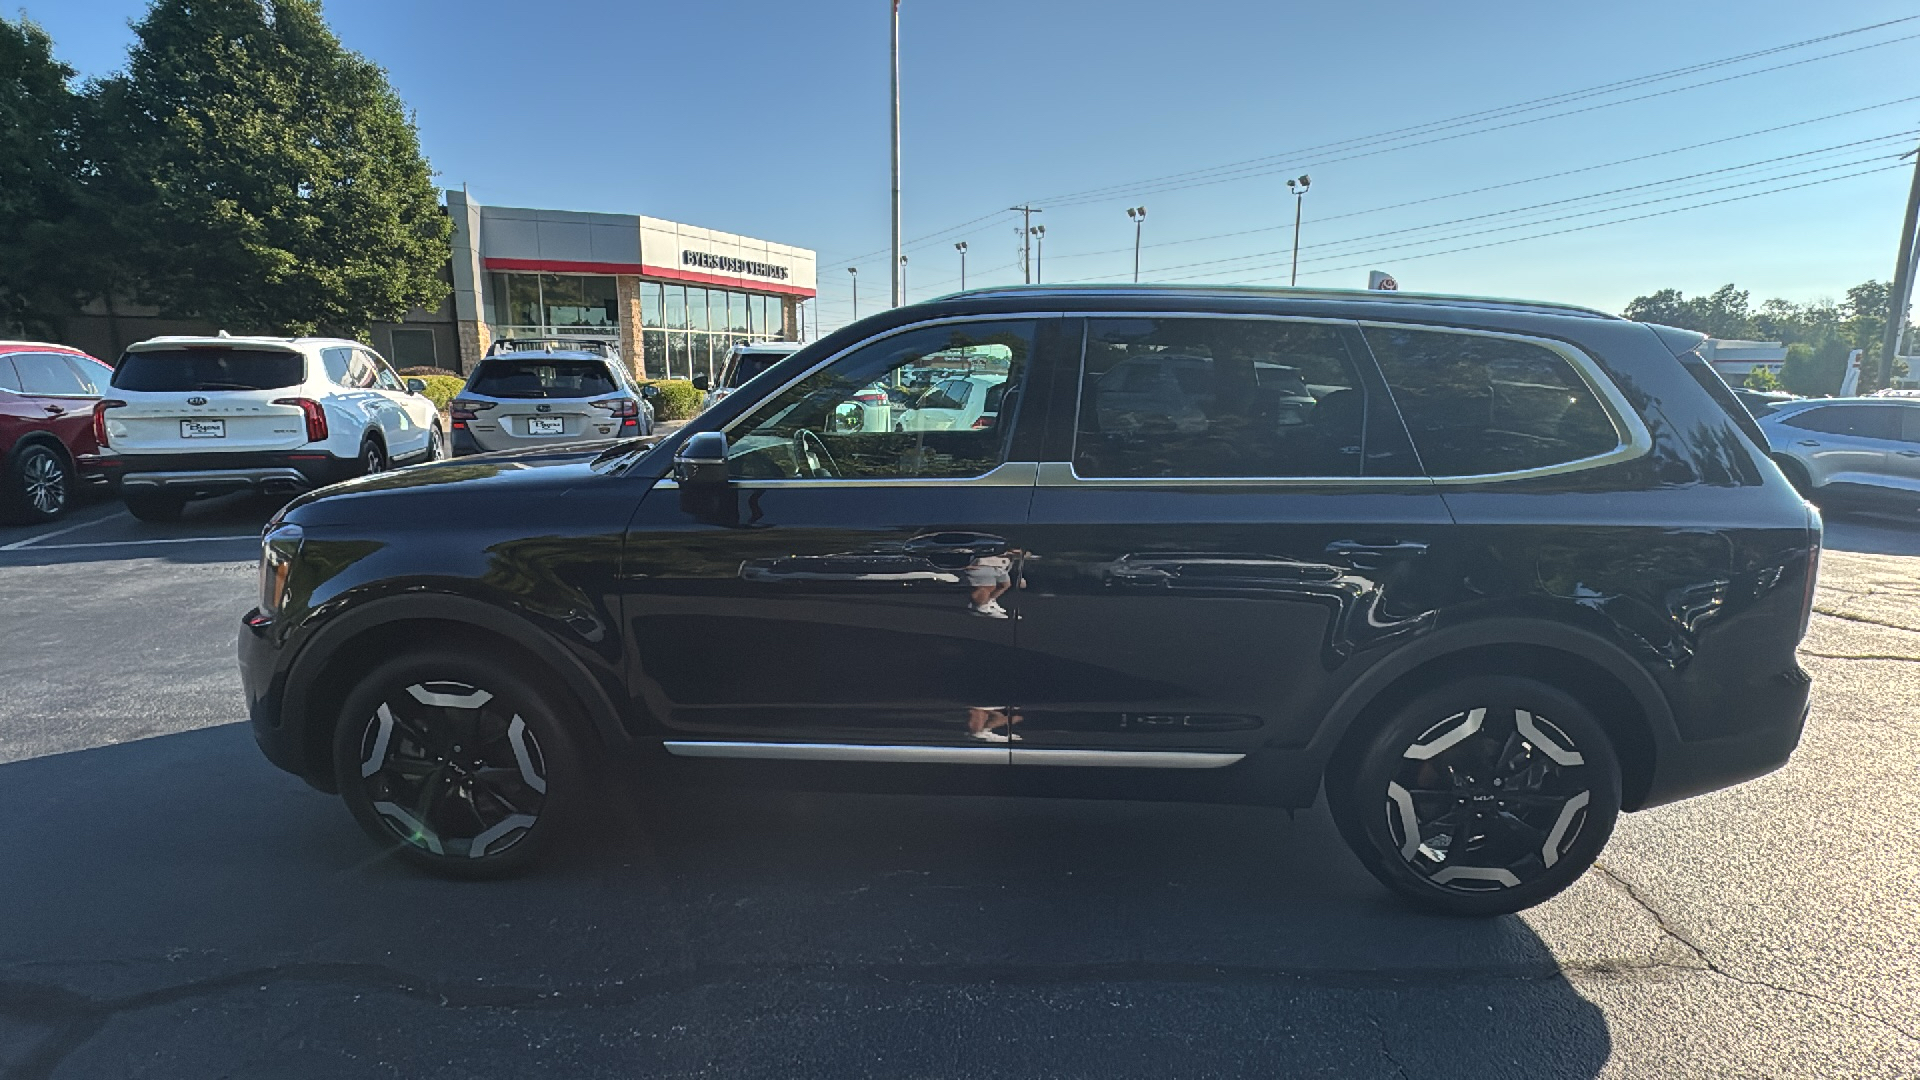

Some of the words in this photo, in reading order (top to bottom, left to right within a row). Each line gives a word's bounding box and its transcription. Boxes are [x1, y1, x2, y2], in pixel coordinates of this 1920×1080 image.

[682, 250, 720, 269] BYERS
[720, 256, 747, 273] USED
[745, 260, 788, 279] VEHICLES
[188, 398, 207, 406] KIA
